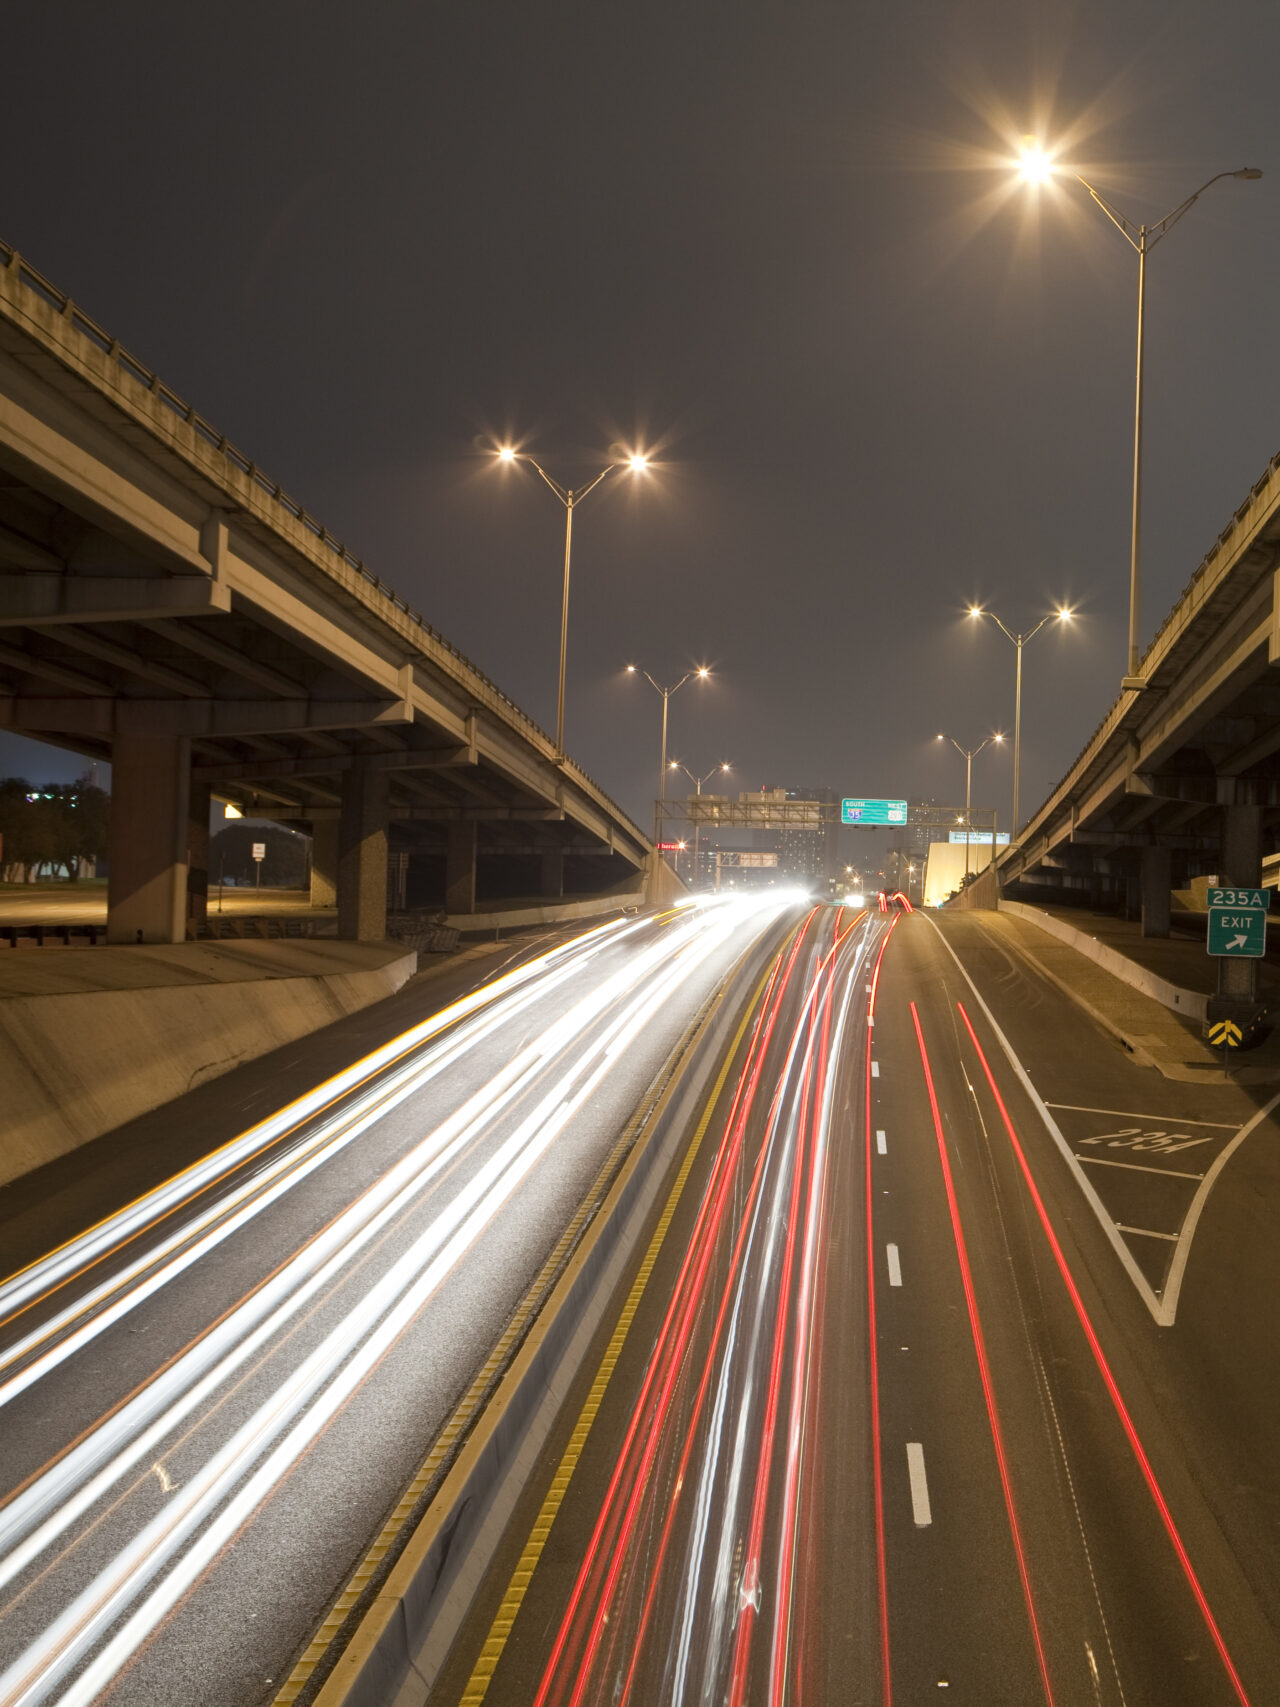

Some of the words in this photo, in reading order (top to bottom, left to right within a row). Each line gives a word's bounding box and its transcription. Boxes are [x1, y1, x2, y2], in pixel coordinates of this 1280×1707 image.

[1213, 891, 1263, 906] 235A
[1221, 917, 1253, 928] EXIT
[1077, 1128, 1214, 1154] 235A
